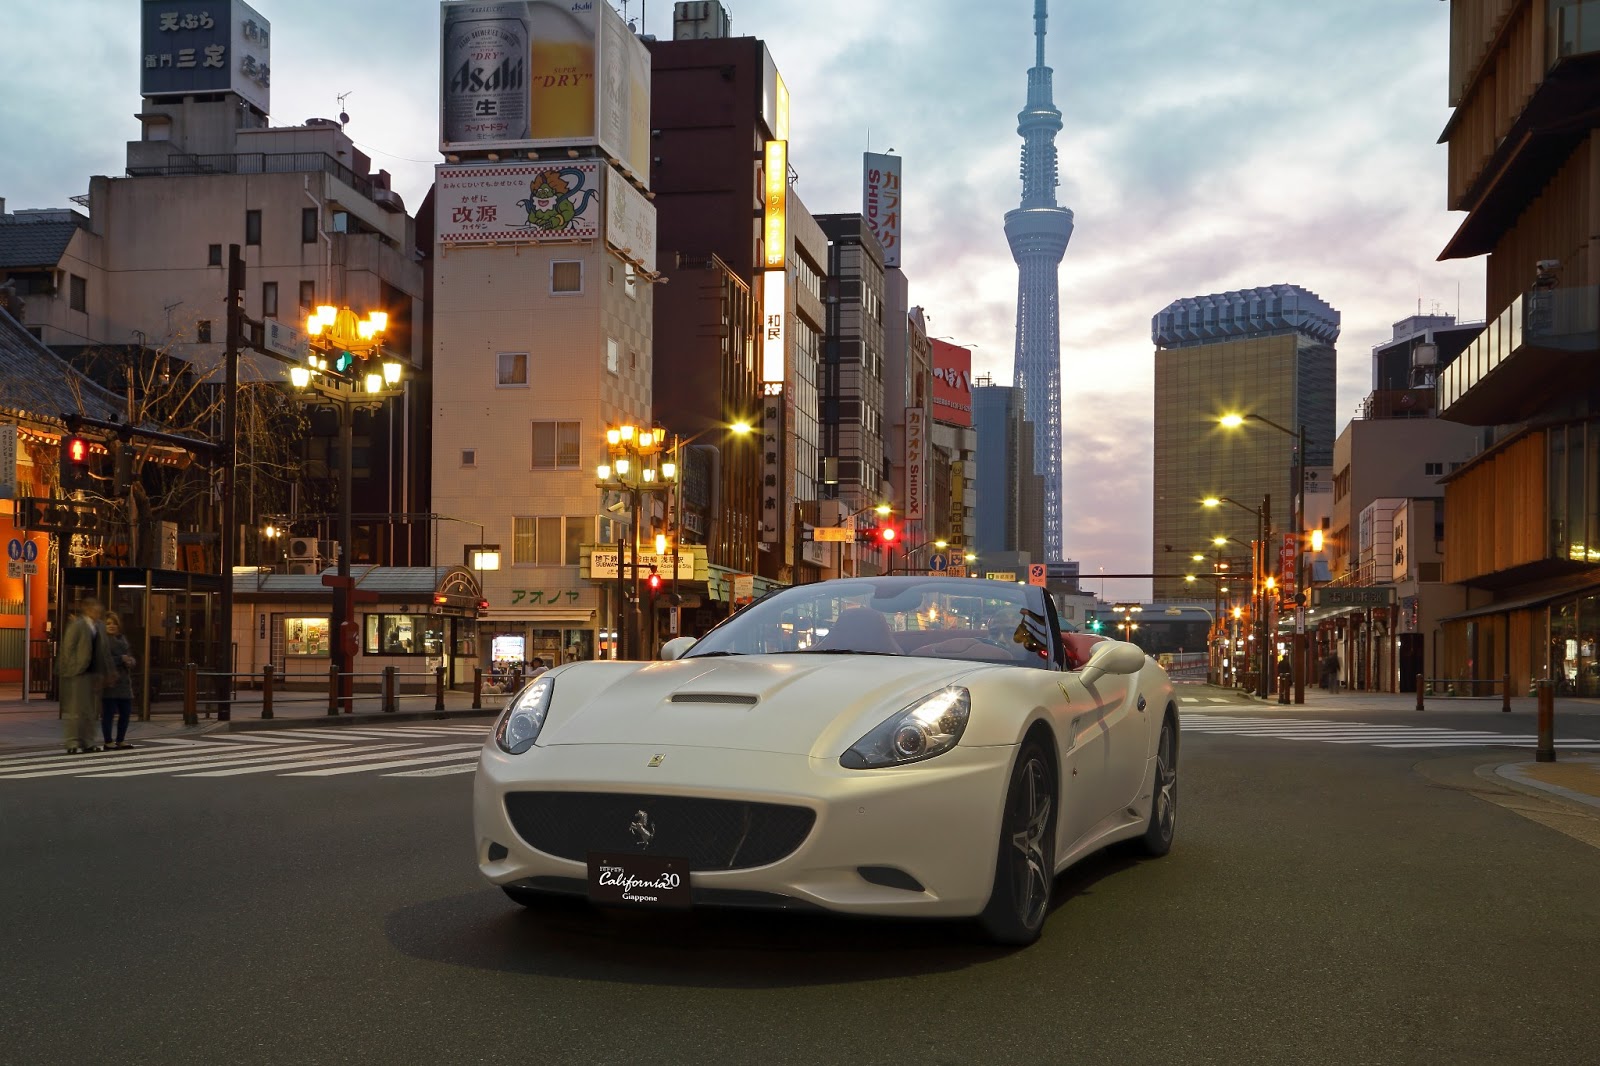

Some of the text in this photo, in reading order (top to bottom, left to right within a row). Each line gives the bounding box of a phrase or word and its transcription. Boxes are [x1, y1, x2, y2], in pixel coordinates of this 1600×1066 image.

[572, 2, 592, 11] Asahi
[159, 11, 215, 32] 天ぷら
[144, 43, 226, 68] 雷門 三定
[450, 56, 523, 94] Asahi
[554, 66, 577, 74] SUPER
[475, 98, 498, 117] 生
[464, 122, 510, 133] スーパードライ
[461, 194, 488, 204] かぜに
[451, 204, 498, 224] 改源
[882, 170, 899, 249] カラオケ
[462, 223, 488, 231] カイゲン
[768, 254, 782, 265] 5F
[767, 314, 781, 341] 和民
[908, 411, 921, 514] カラオケ SHIDAX
[595, 554, 618, 563] 地下鉄
[512, 589, 580, 605] アオノヤ
[599, 871, 681, 893] California 30
[622, 893, 658, 903] Giappone
